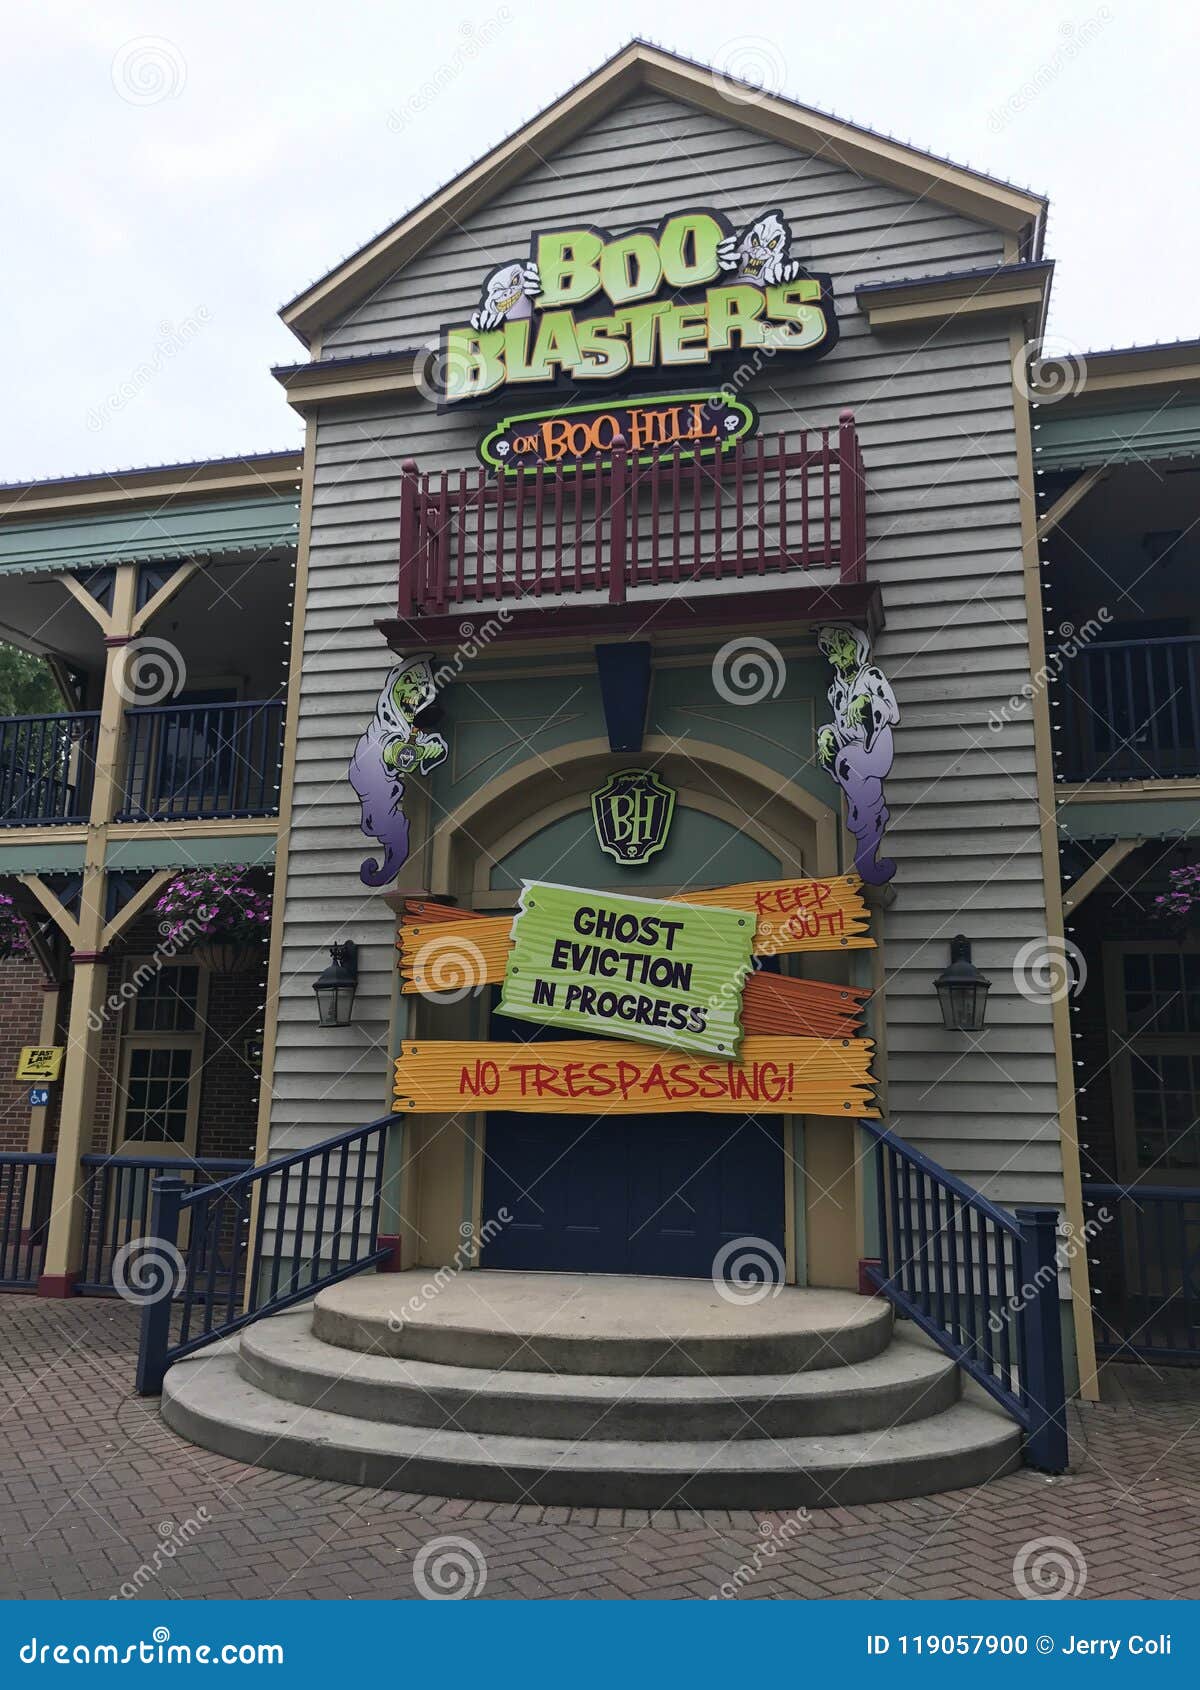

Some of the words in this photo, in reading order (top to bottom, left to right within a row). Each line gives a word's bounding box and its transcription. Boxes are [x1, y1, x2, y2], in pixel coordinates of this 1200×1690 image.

[535, 213, 726, 309] BOO
[446, 279, 829, 400] BLASTERS
[512, 434, 539, 454] ON
[539, 418, 621, 461] BOO
[626, 403, 718, 454] HILL
[608, 787, 659, 846] BH
[755, 883, 832, 916] KEEP
[788, 909, 845, 939] OUT!
[573, 907, 685, 951] GHOST
[551, 941, 694, 992] EVICTION
[532, 979, 557, 1007] IN
[565, 991, 708, 1034] PROGRESS
[459, 1060, 500, 1096] NO
[508, 1060, 795, 1102] TRESPASSING!
